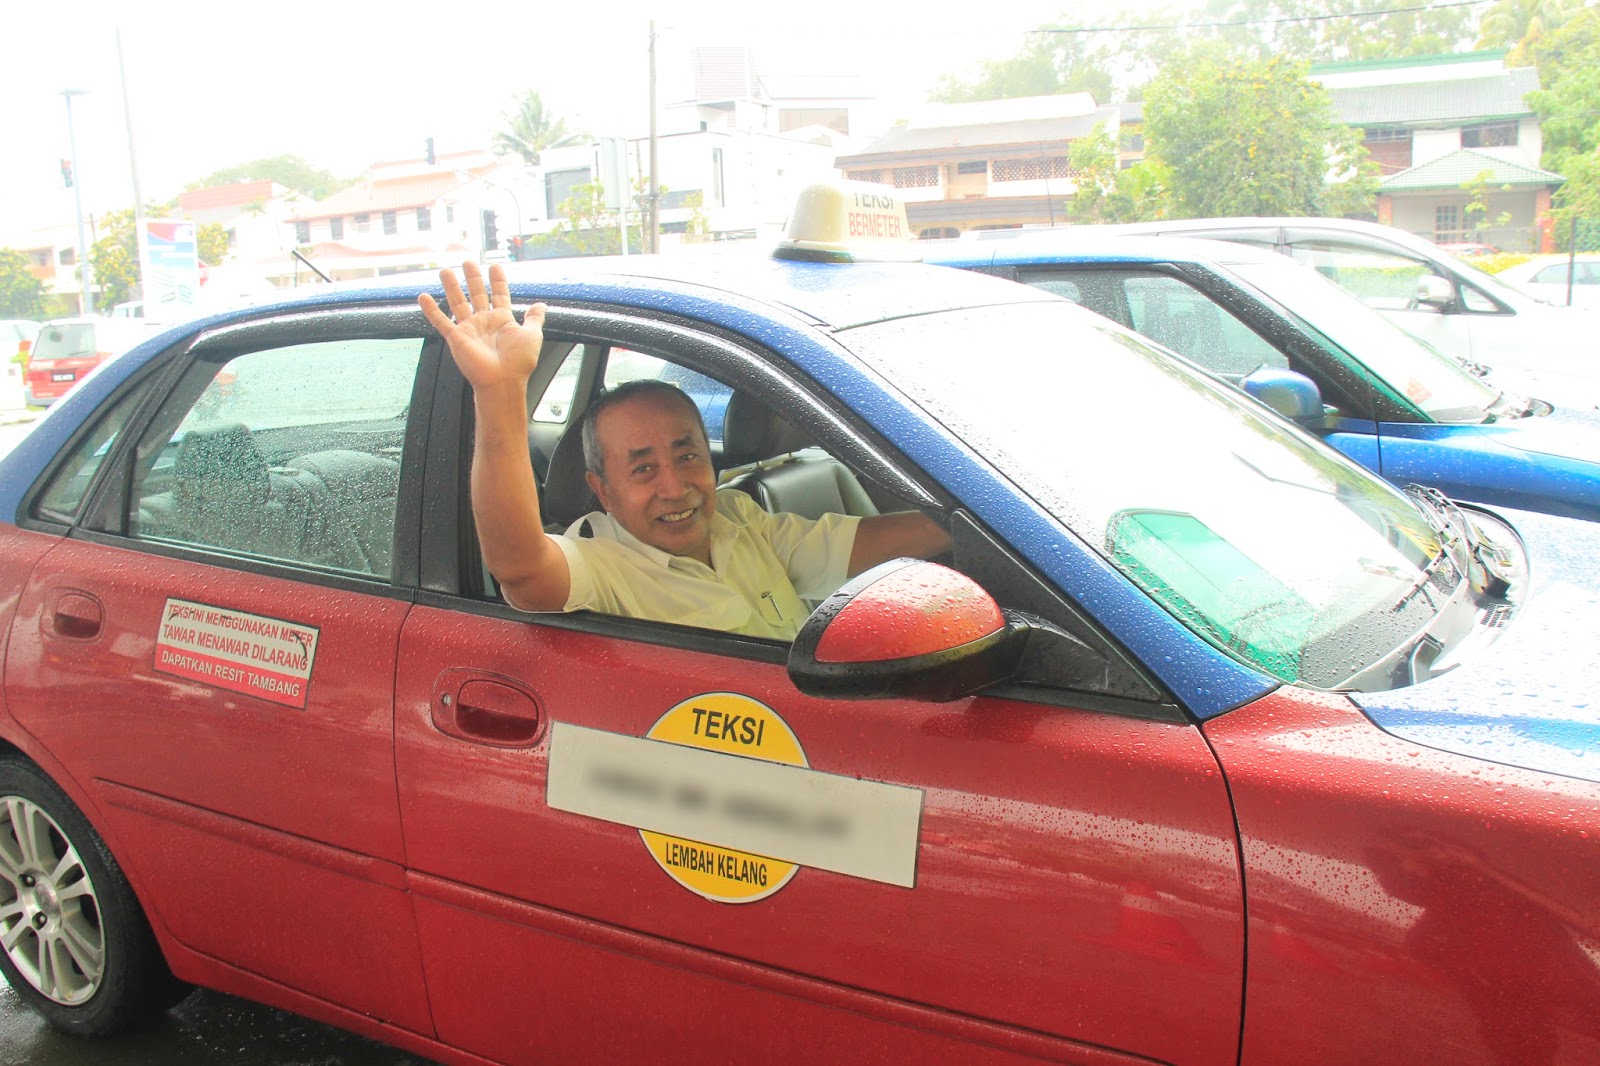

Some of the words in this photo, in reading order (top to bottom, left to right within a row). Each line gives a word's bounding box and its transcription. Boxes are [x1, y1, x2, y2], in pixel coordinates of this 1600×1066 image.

[848, 211, 902, 238] BERMETER
[164, 623, 196, 645] TAWAR
[197, 631, 250, 658] MENAWAR
[251, 643, 309, 671] DILARANG
[205, 611, 279, 639] MENGGUNAKAN
[280, 626, 313, 648] METER
[161, 650, 213, 675] DAPATKAN
[214, 664, 245, 683] RESIT
[247, 672, 300, 697] TAMBANG
[692, 707, 765, 747] TEKSI
[665, 841, 715, 875] LEMBAH
[717, 854, 768, 887] KELANG
